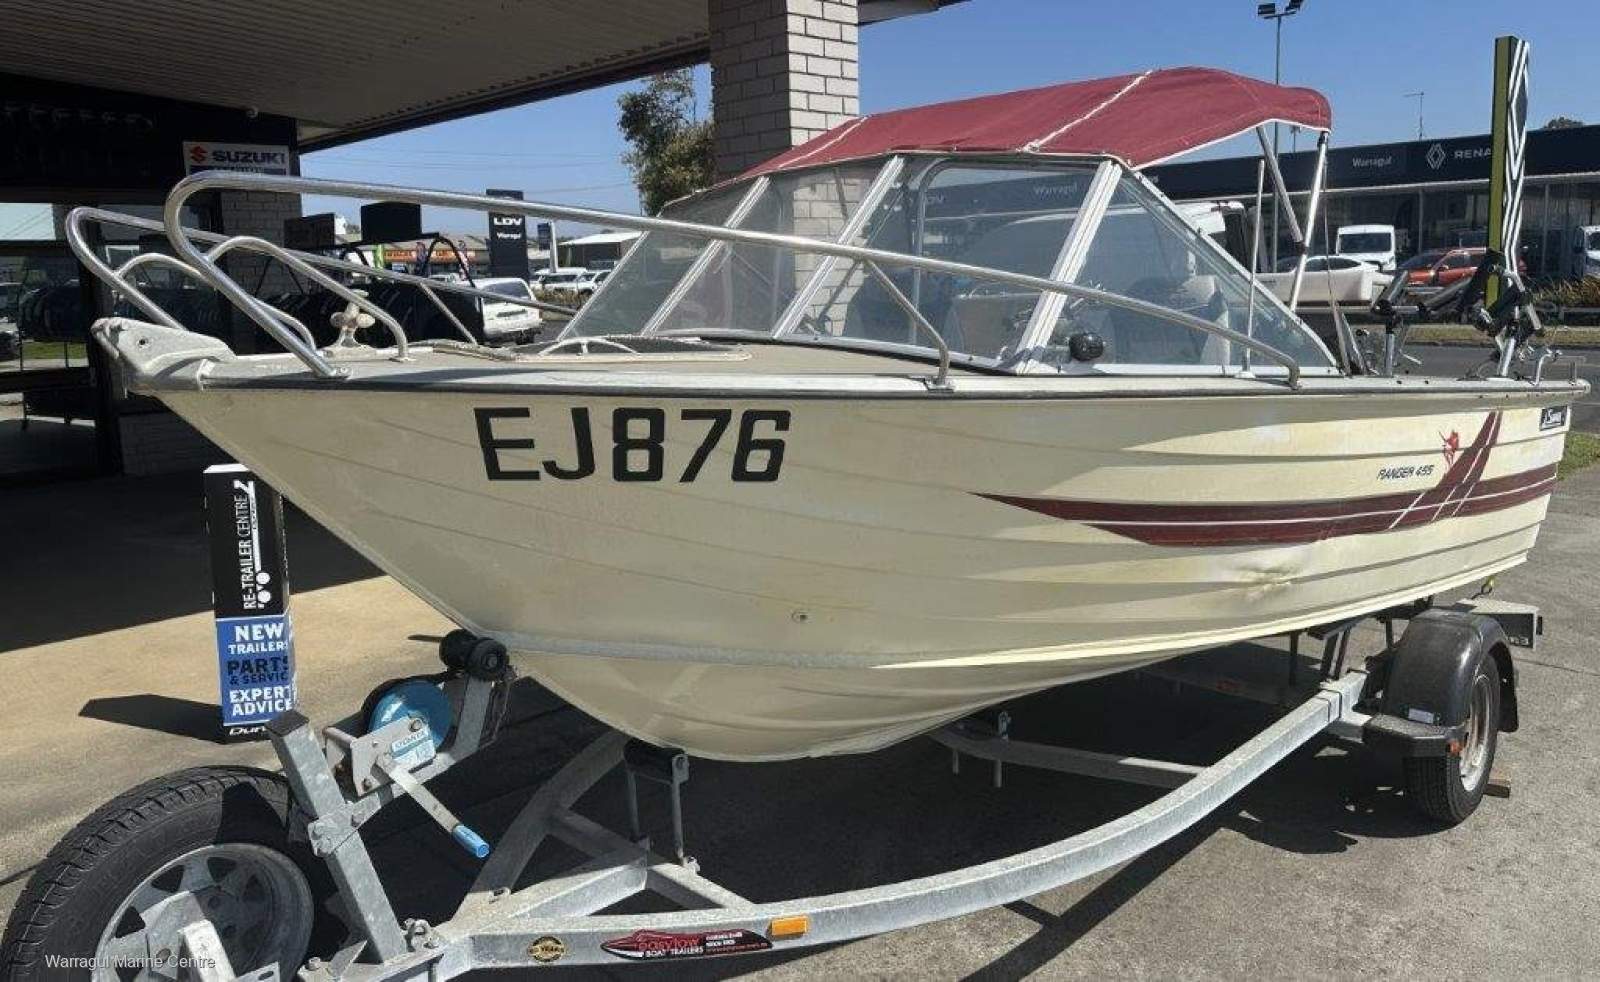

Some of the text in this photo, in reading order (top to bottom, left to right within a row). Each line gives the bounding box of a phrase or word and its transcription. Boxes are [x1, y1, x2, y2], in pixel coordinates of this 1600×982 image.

[212, 150, 286, 164] SUZUKI
[493, 217, 522, 226] LDV
[474, 407, 791, 482] EJ876
[234, 494, 257, 609] RE-TRAILER CENTRE
[234, 623, 284, 641] NEW
[232, 699, 292, 717] ADVICE
